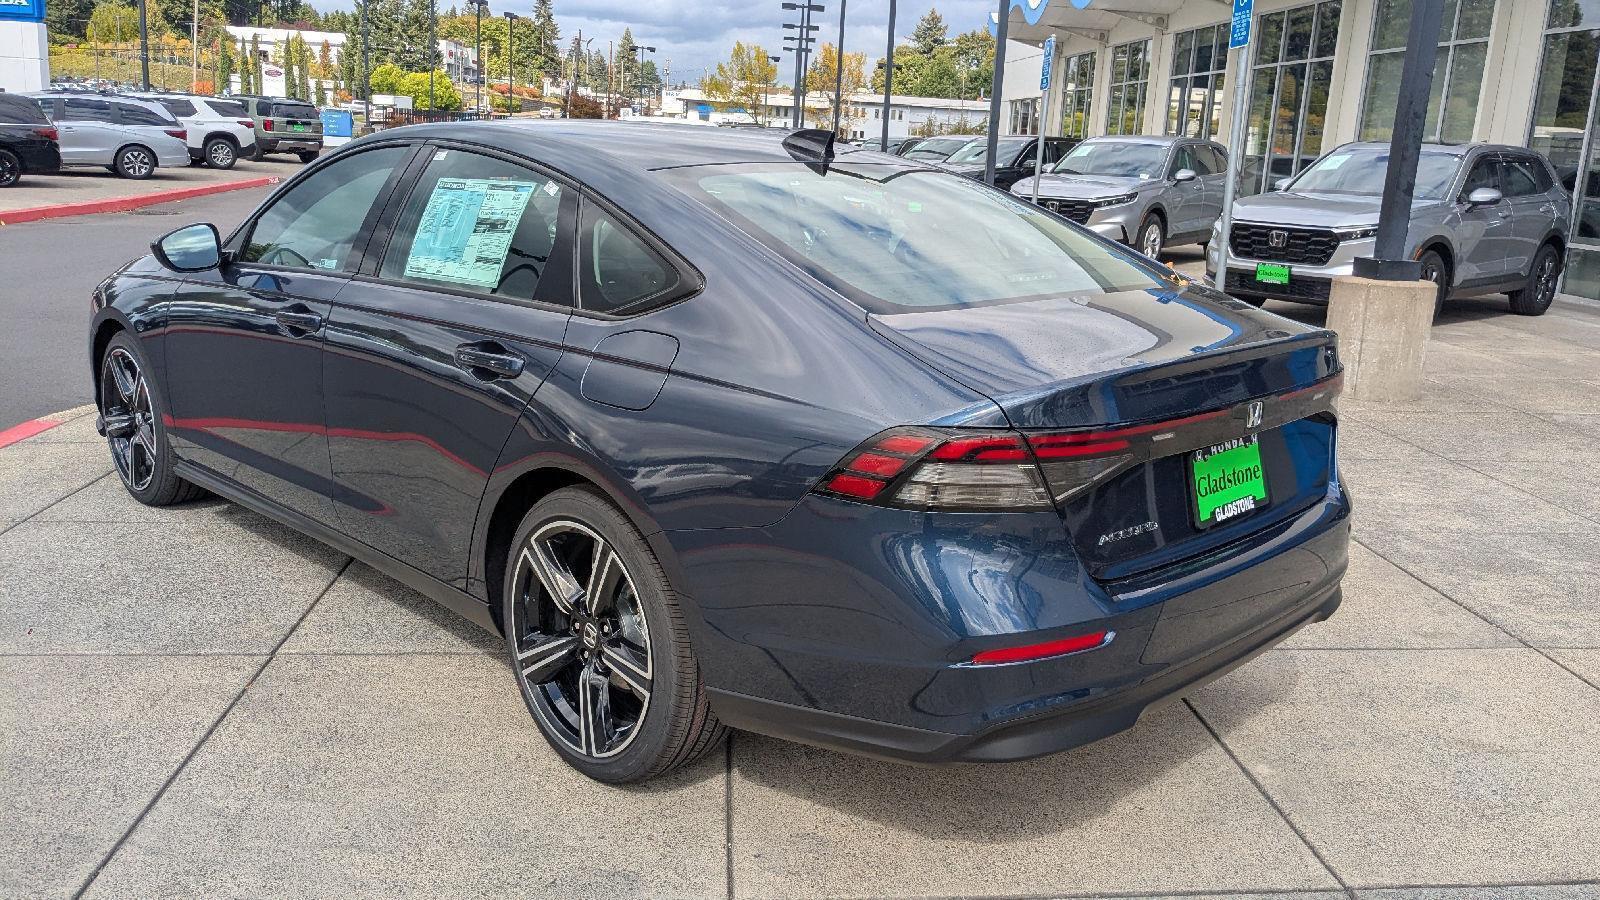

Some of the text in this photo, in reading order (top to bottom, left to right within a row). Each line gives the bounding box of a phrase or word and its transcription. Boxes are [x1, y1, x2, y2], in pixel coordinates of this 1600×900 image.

[1211, 437, 1244, 455] HONDA
[1197, 464, 1260, 497] Gladstone
[1215, 495, 1254, 521] GLADSTONE
